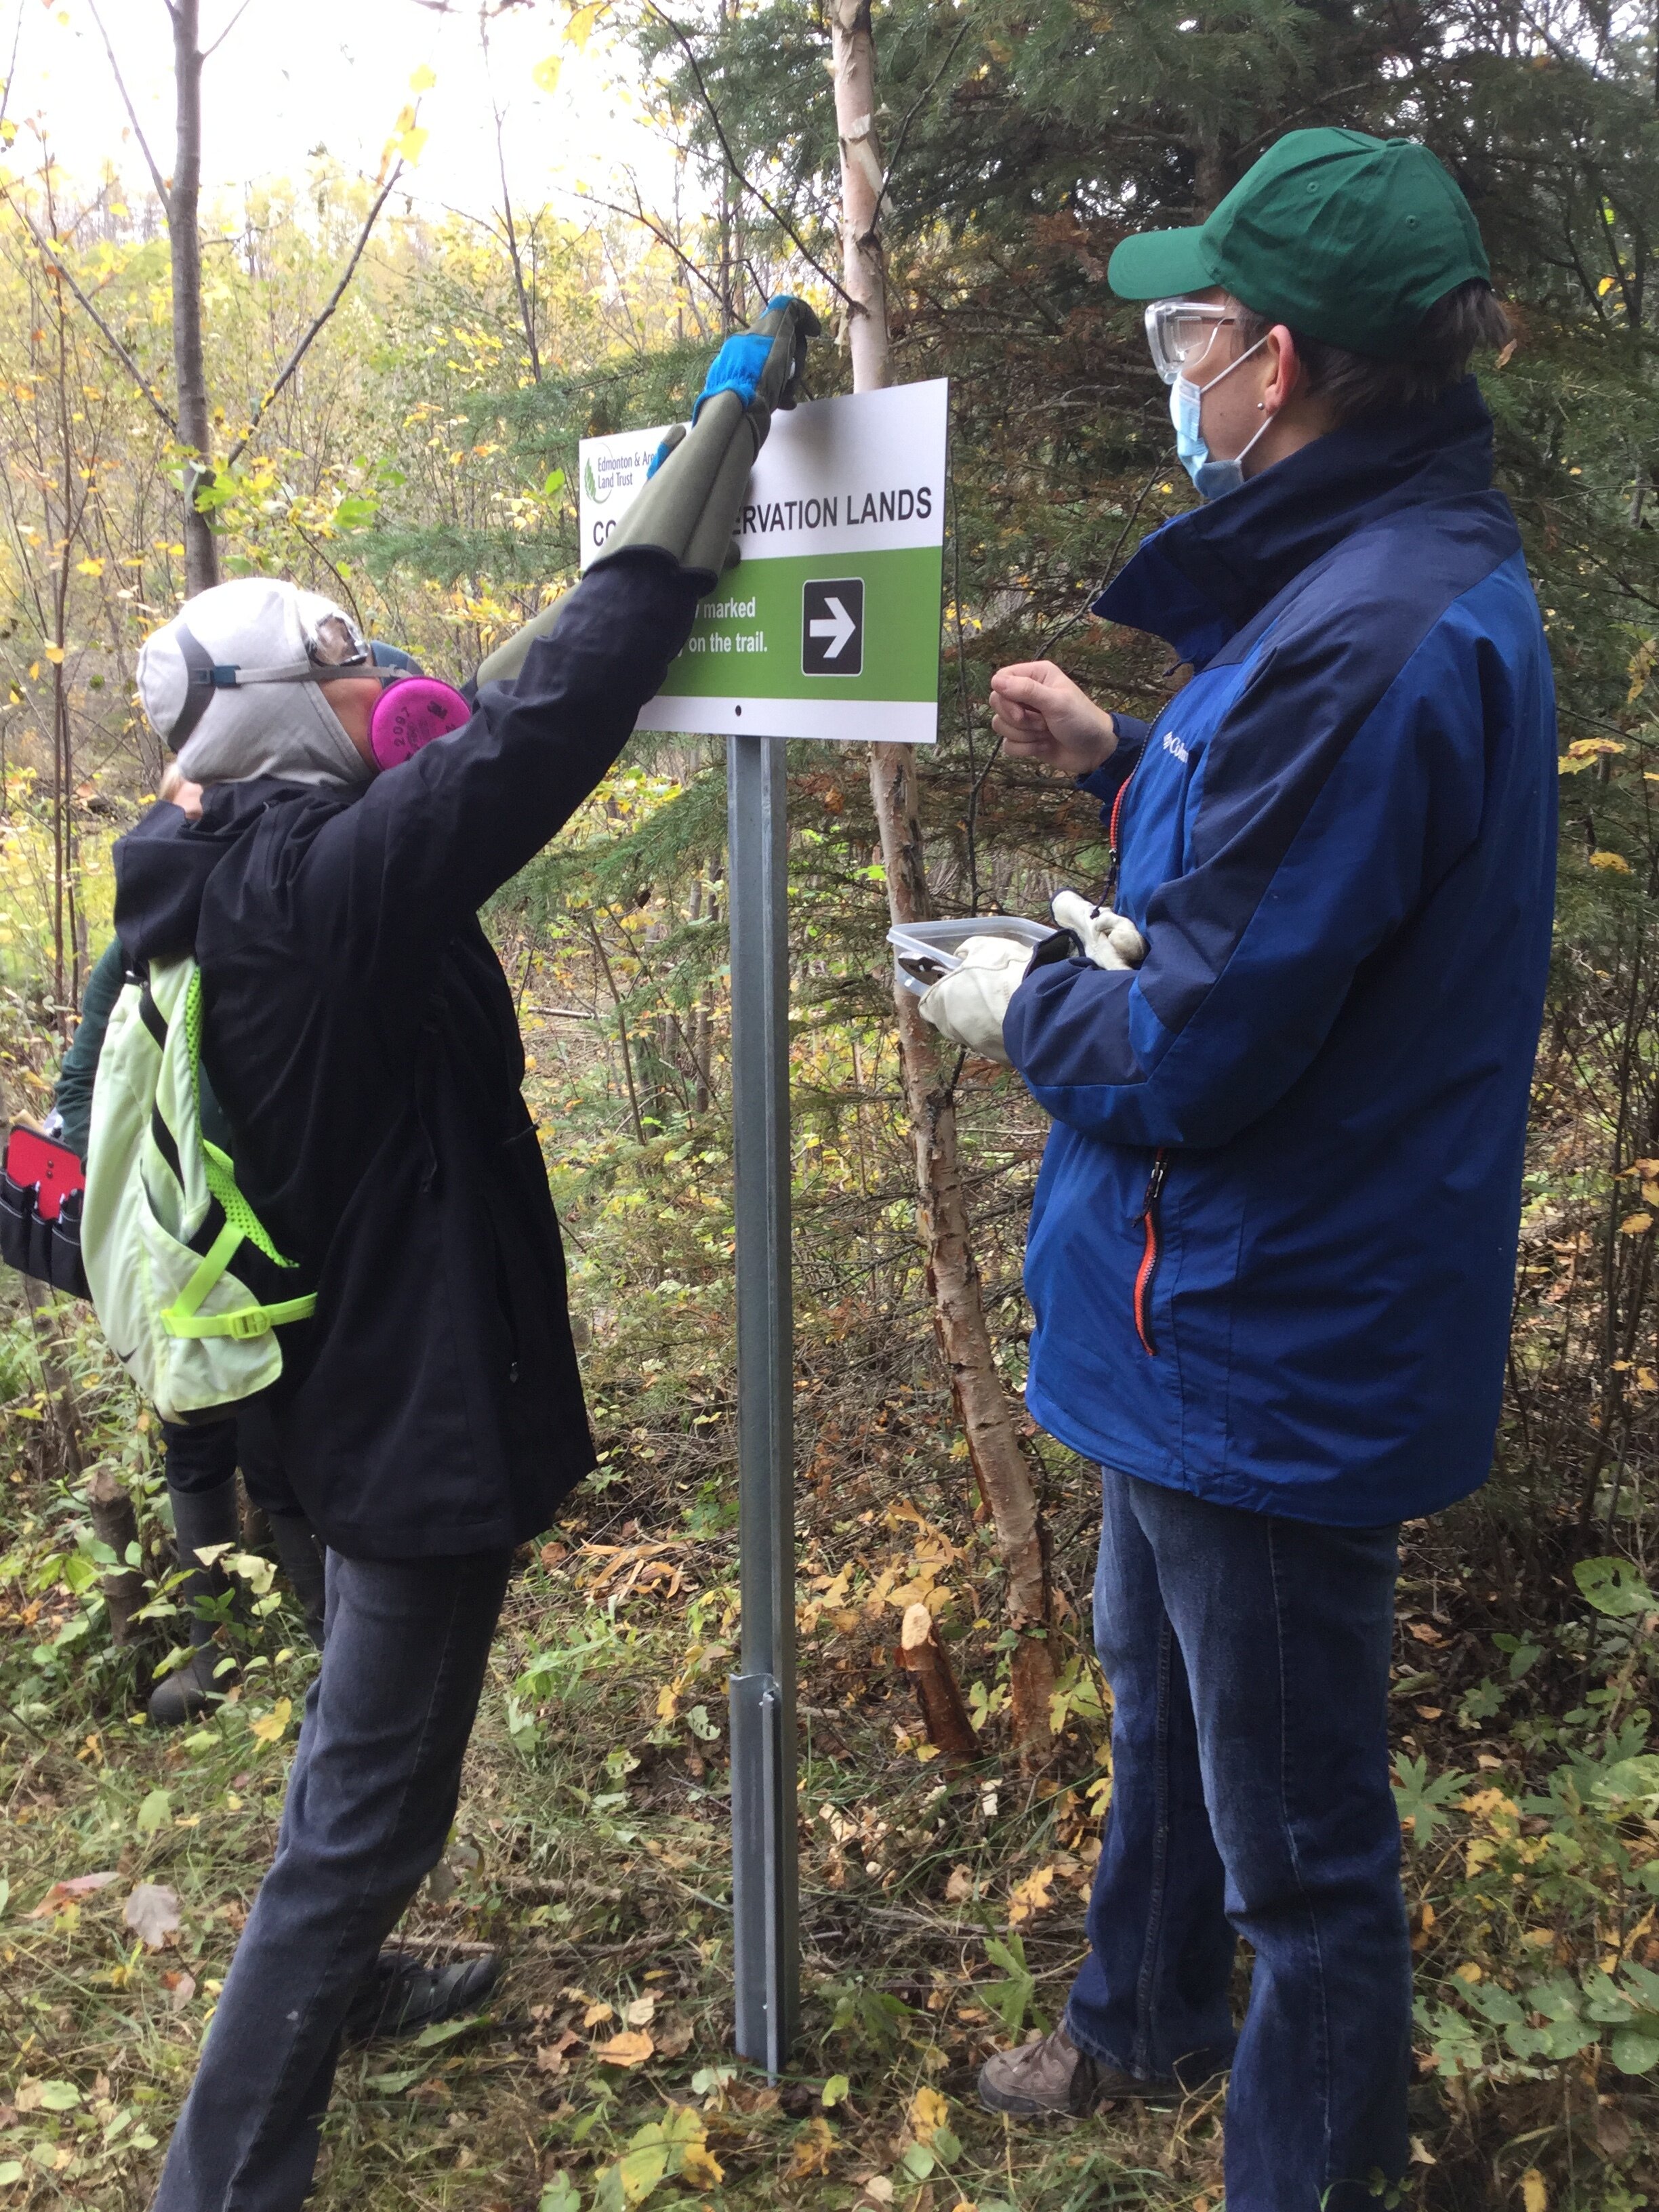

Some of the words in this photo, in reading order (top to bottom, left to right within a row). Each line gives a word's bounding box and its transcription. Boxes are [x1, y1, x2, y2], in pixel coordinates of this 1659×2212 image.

[598, 455, 632, 472] Edmonton
[634, 452, 640, 466] &
[598, 474, 614, 489] Land
[616, 472, 633, 486] Trust
[847, 487, 932, 525] LANDS
[703, 596, 756, 619] marked
[689, 637, 705, 653] on
[710, 632, 732, 653] the
[735, 631, 768, 653] trail.
